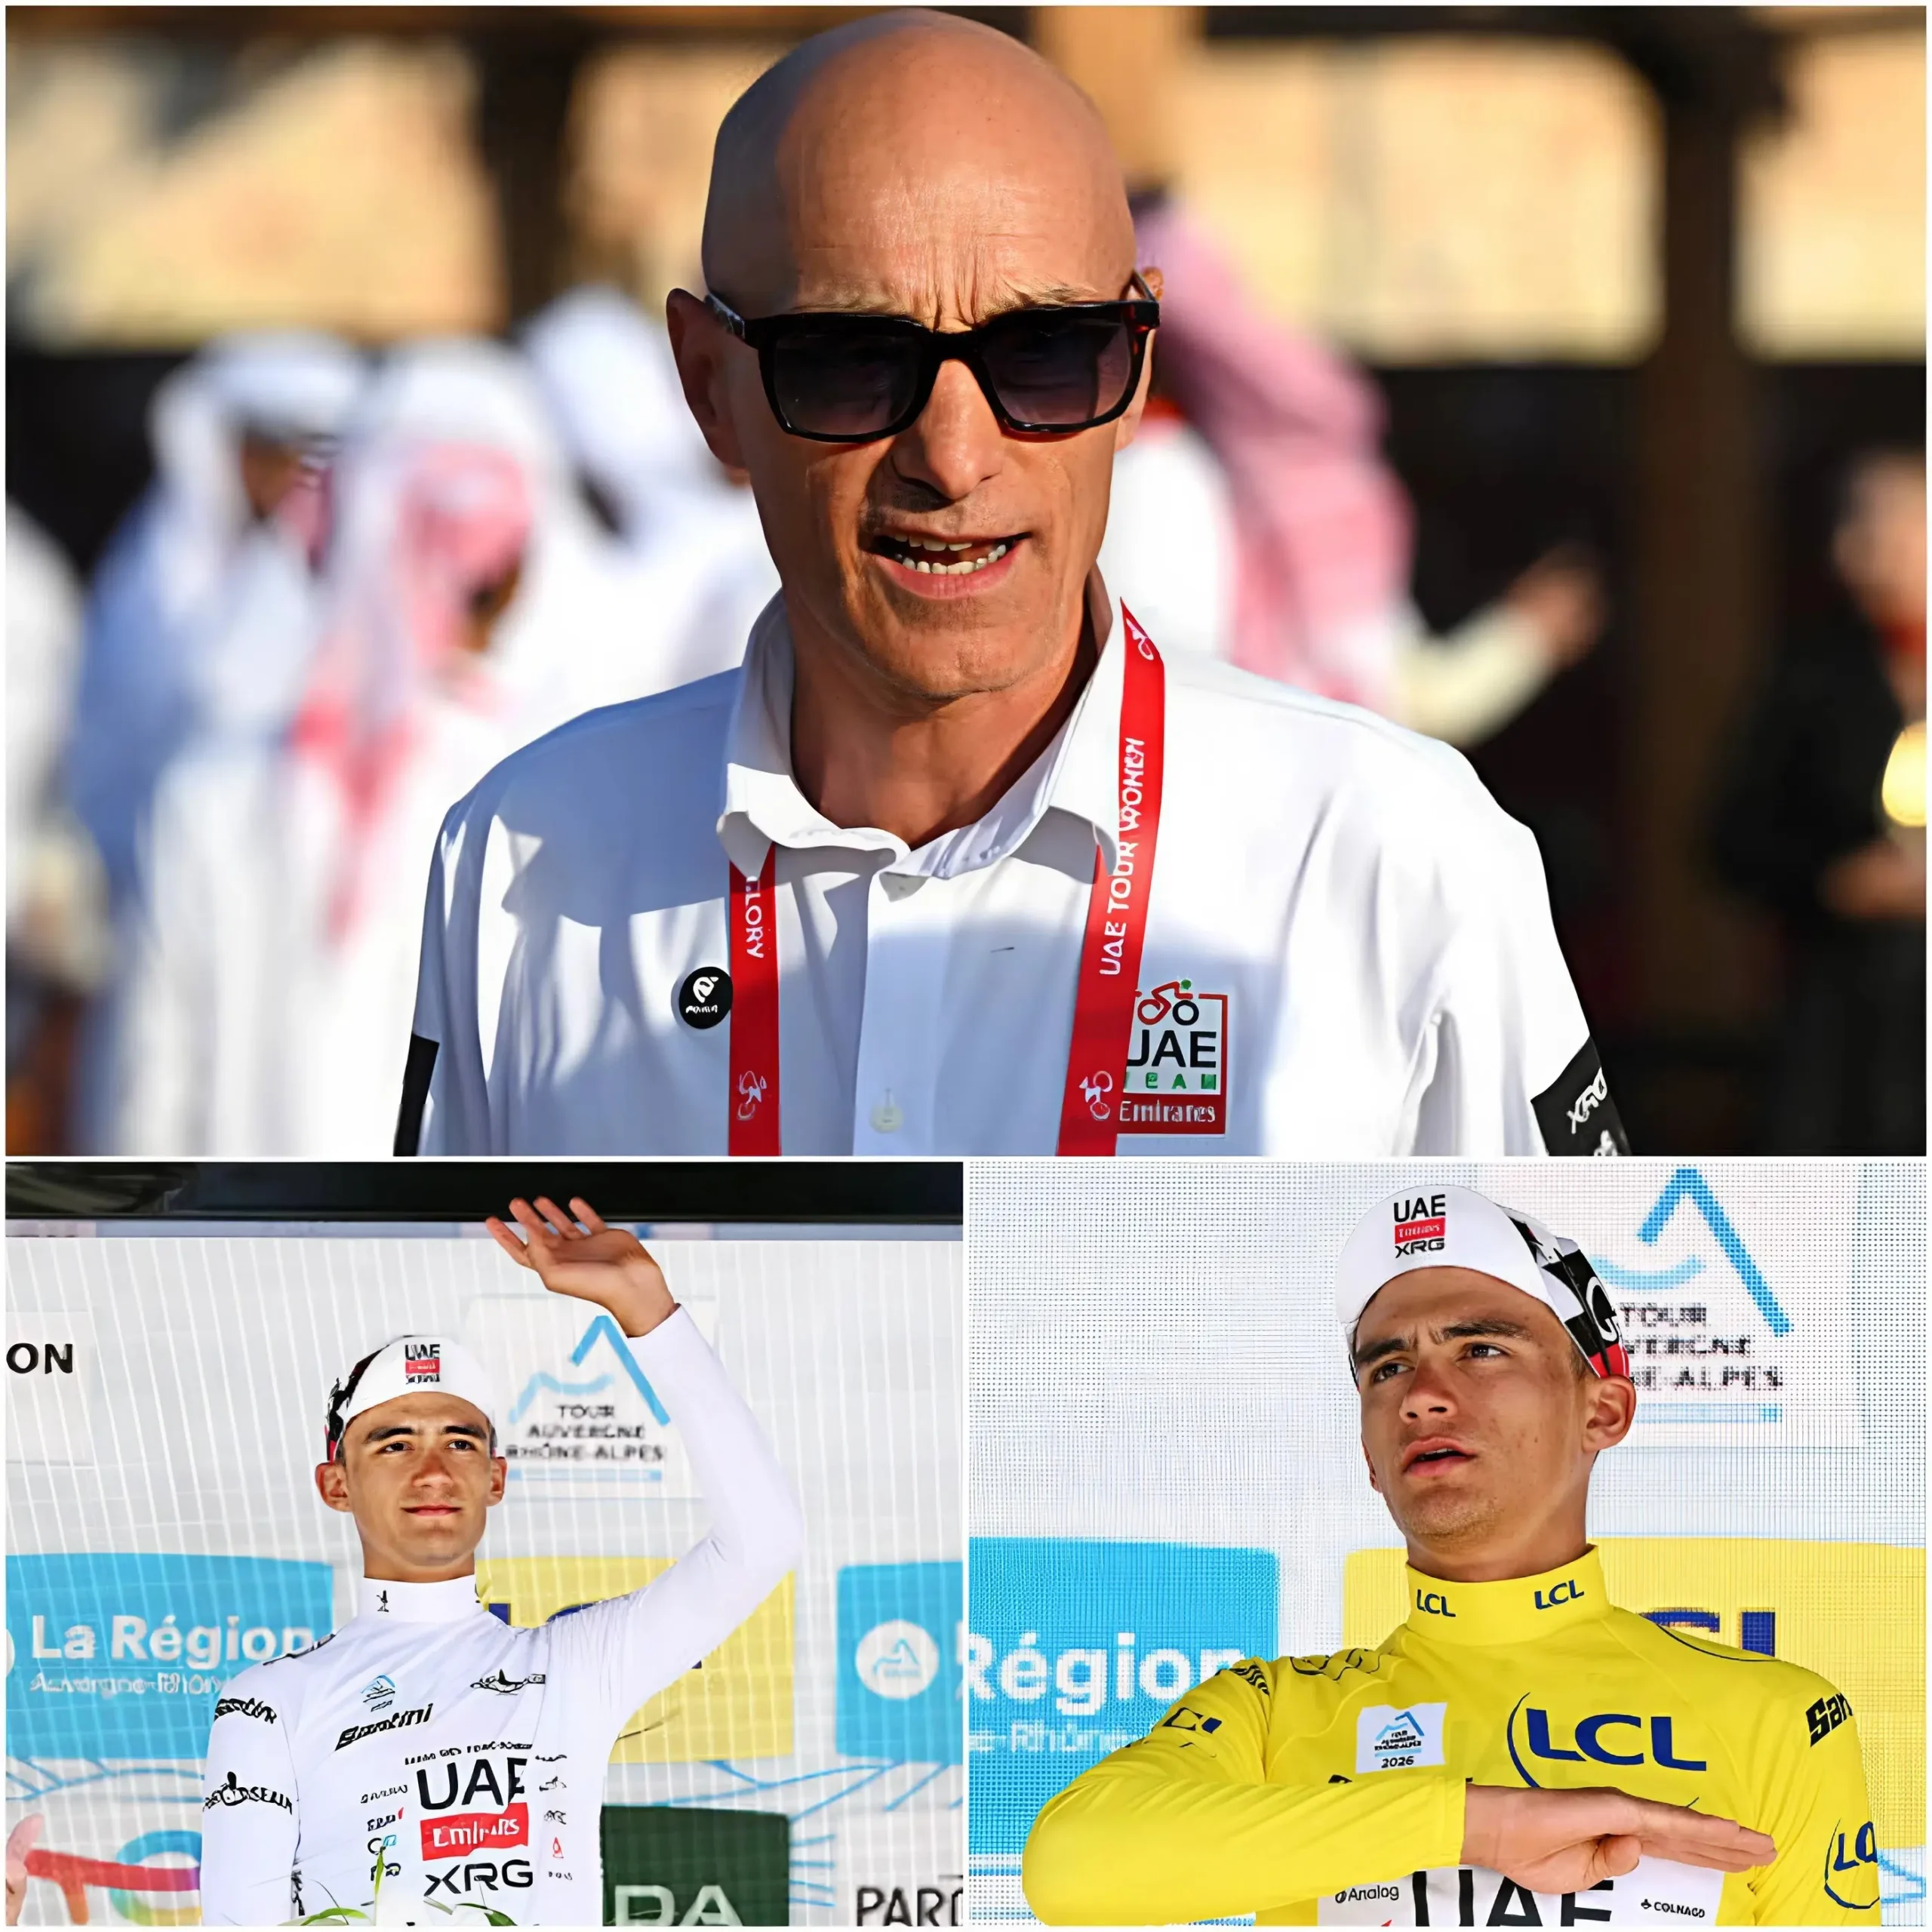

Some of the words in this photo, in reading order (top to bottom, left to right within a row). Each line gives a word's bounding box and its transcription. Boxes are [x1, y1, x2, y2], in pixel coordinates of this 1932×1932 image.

[1107, 841, 1139, 915] TOUR
[745, 884, 764, 958] LORY
[1099, 920, 1127, 976] UAE
[1393, 1193, 1446, 1223] UAE
[1395, 1238, 1445, 1259] XRG
[8, 1342, 74, 1374] ON
[1417, 1588, 1457, 1618] LCL
[1534, 1579, 1586, 1610] LCL
[32, 1614, 95, 1660] La
[112, 1614, 314, 1670] Région
[1525, 1707, 1707, 1772] LCL
[1380, 1755, 1415, 1769] 2026
[416, 1756, 528, 1810] UAE
[423, 1859, 534, 1897] XRG
[1348, 1884, 1400, 1903] Analog
[1654, 1901, 1706, 1919] COLNAGO
